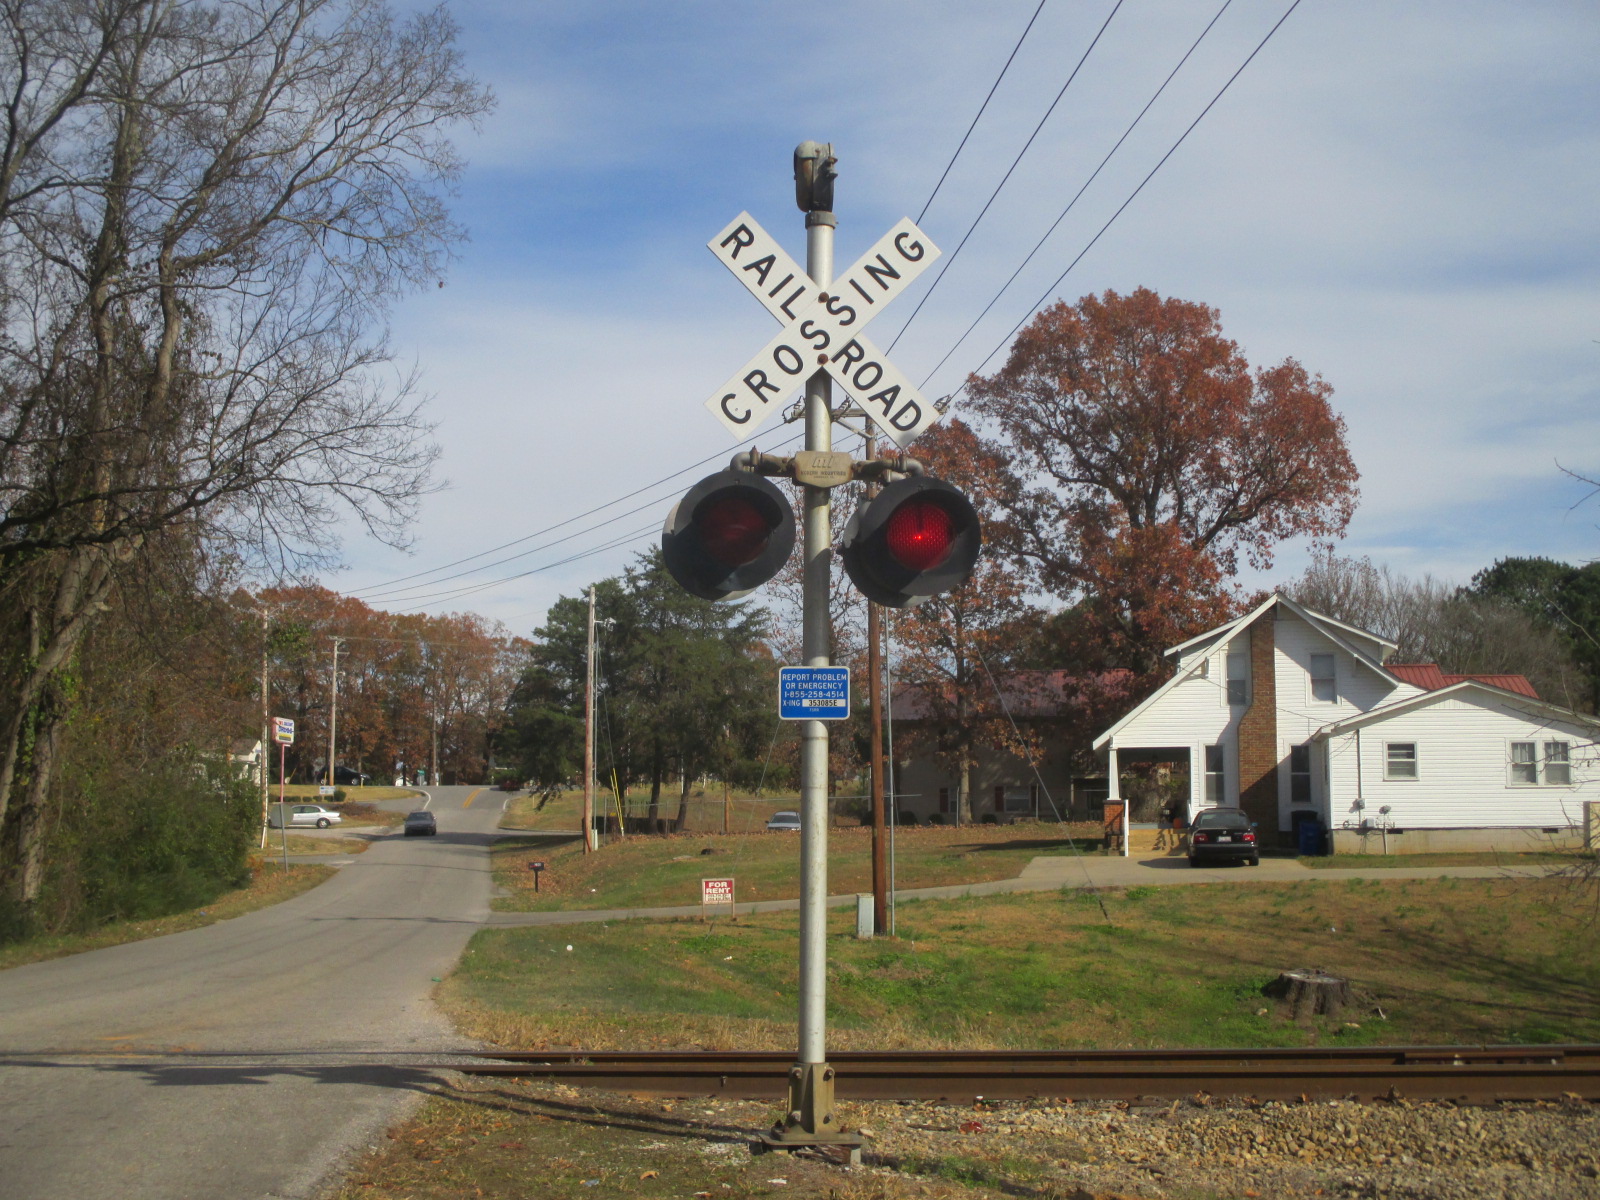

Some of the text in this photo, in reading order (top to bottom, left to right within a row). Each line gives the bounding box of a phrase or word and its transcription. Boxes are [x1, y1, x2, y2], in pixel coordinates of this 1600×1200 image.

[720, 223, 922, 431] RAIL ROAD
[720, 232, 925, 424] CROSSING
